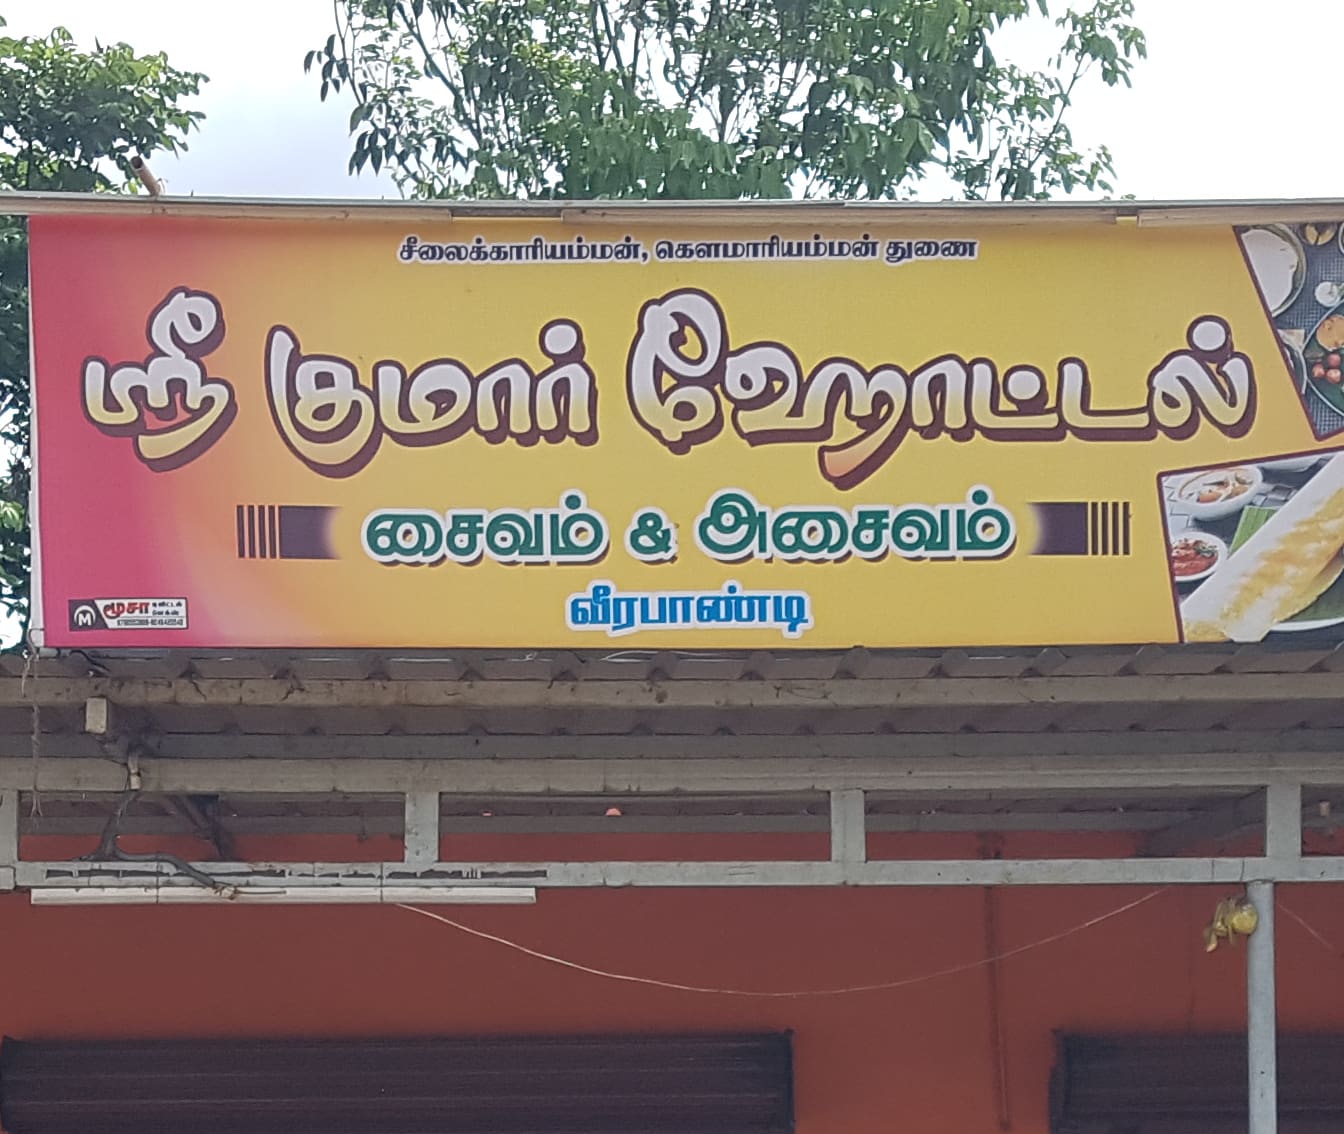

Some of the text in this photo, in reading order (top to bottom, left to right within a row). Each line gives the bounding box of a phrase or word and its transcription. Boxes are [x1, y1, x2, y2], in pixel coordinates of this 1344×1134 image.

[399, 235, 649, 262] சீலைக்காரியம்மன்,
[886, 239, 978, 264] துணை
[265, 318, 599, 478] குமார்
[627, 286, 1256, 490] ஹோட்டல்
[361, 486, 1018, 566] சைவம் & அசைவம்
[568, 581, 812, 636] வீரபாண்டி
